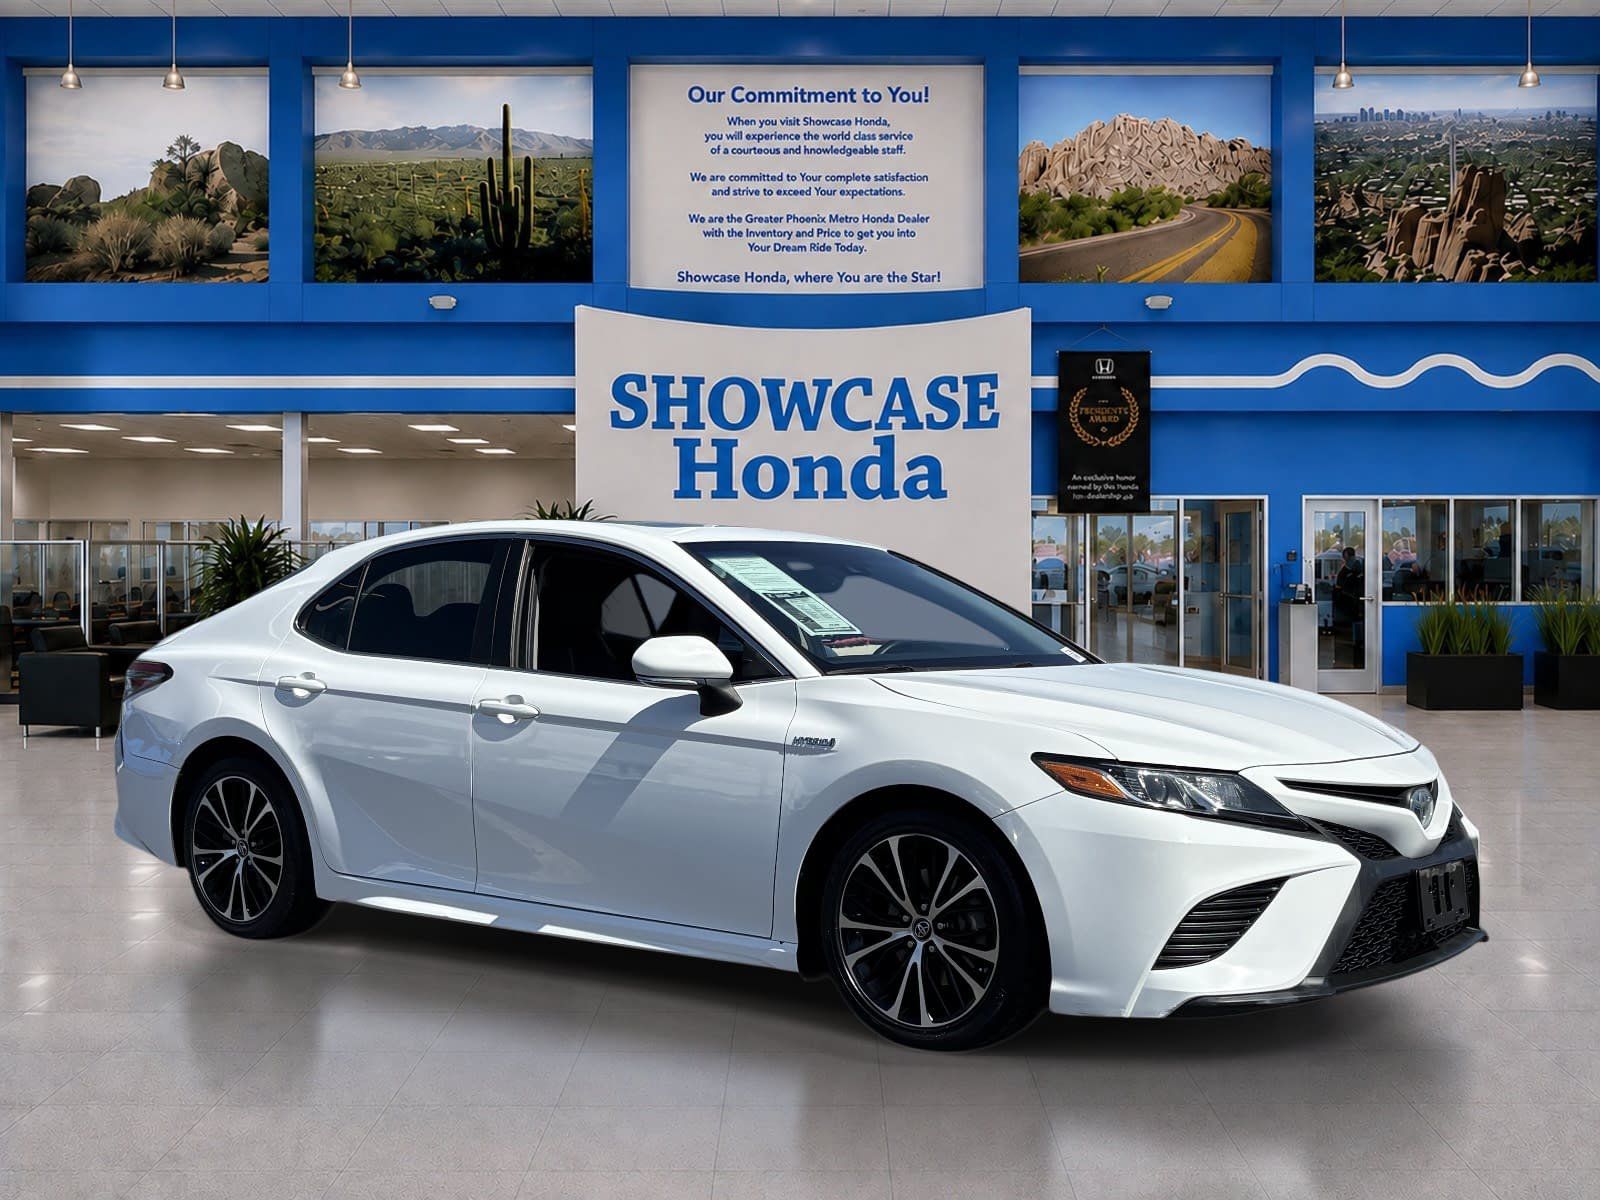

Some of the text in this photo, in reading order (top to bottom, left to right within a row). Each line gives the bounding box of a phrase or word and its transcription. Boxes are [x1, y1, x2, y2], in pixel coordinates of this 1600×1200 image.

[687, 85, 930, 104] Our Commitment to You!
[726, 115, 891, 129] When you visit Showcase Honda,
[704, 130, 914, 144] you will experience the world class service
[709, 144, 722, 155] of
[730, 146, 781, 156] courteous
[782, 144, 802, 155] and
[881, 144, 907, 155] staff.
[689, 171, 929, 185] We are committed to Your complete satisfaction
[711, 185, 906, 200] and strive to exceed Your expectations.
[688, 213, 931, 224] We are the Greater Phoenix Metro Honda Dealer
[702, 227, 917, 241] with the Inventory and Price to get you into
[747, 242, 868, 255] Your Dream Ride Today.
[676, 270, 941, 286] Showcase Honda, where You are the Star!
[610, 372, 1000, 432] SHOWCASE
[672, 434, 948, 500] Honda
